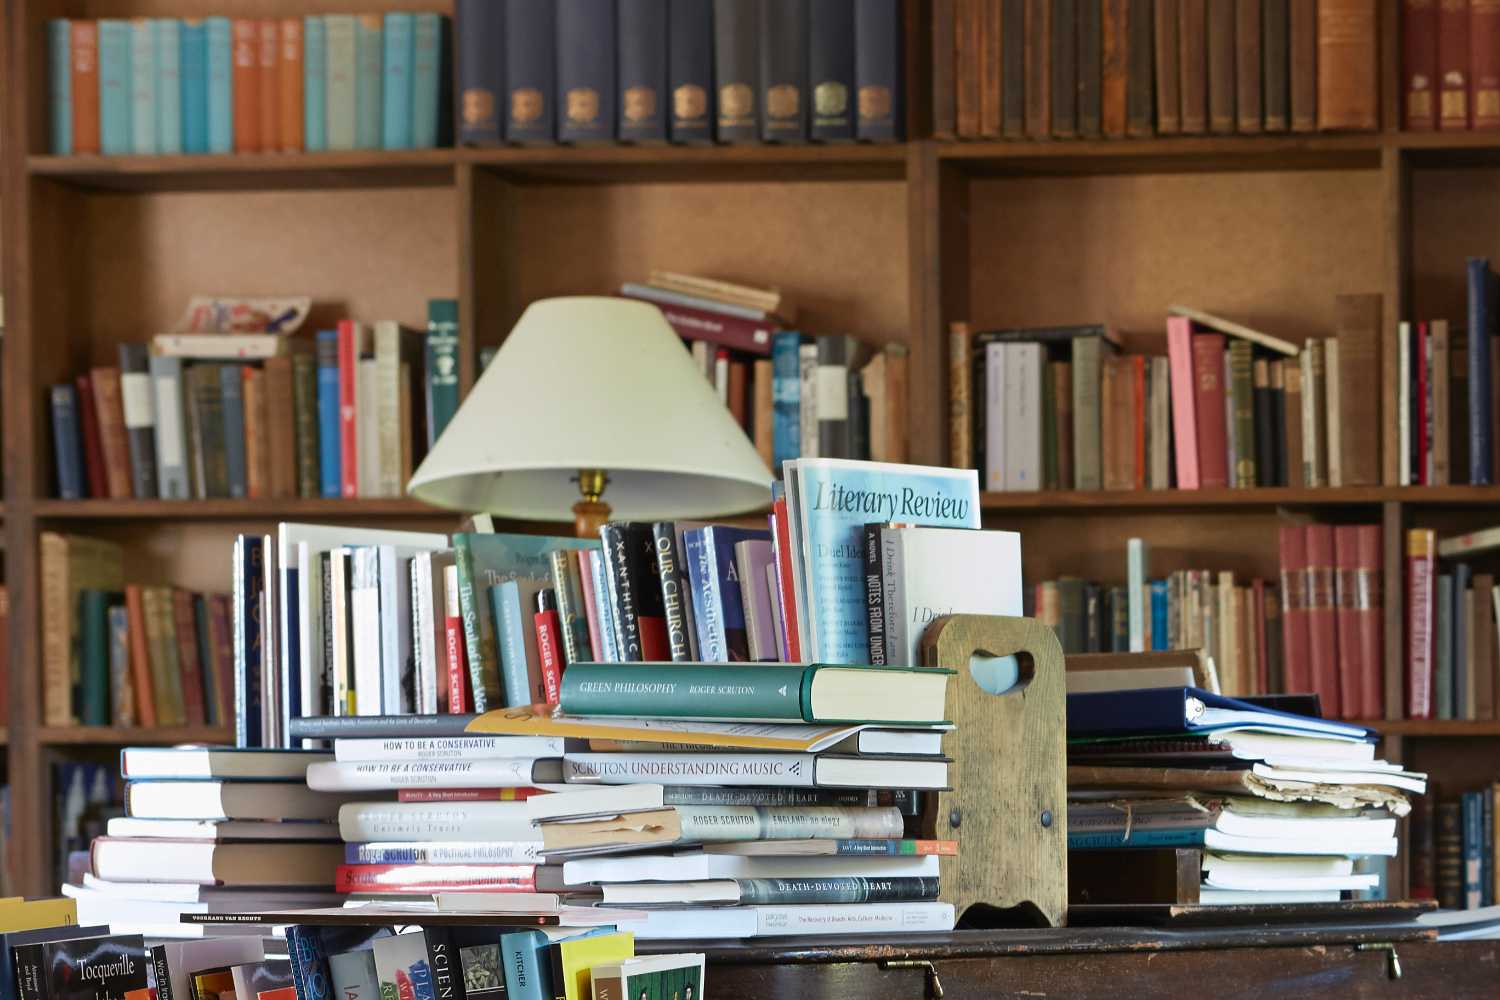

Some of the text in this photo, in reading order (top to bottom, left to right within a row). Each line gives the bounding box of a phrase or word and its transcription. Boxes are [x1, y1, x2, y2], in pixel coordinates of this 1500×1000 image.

[813, 481, 969, 521] Literary Review
[886, 548, 898, 578] Drink
[461, 583, 473, 605] The
[616, 541, 638, 653] XANTHIPPIC
[656, 537, 686, 657] OUR CHURCH
[887, 580, 899, 633] Therefore
[463, 611, 477, 643] Soul
[701, 575, 721, 663] Aesthetics
[866, 575, 885, 666] NOTES FROM UNDER
[447, 628, 459, 670] ROGER
[469, 645, 481, 662] of
[539, 624, 553, 667] ROGER
[472, 665, 484, 689] the
[580, 682, 678, 694] GREEN PHILOSOPHY
[689, 685, 755, 695] ROGER SCRUTON
[383, 738, 497, 751] HOW TO BE A CONSERVATIVE
[356, 762, 473, 773] HOW TO BE A CONSERVATIVE
[572, 760, 784, 776] SCRUTON UNDERSTANDING MUSIC
[693, 815, 755, 825] ROGER SCRUTON
[358, 847, 427, 864] Roger SCRUTON
[778, 881, 893, 891] DEATH-DEVOTED HEART
[77, 953, 136, 985] Tocqueville
[156, 960, 165, 979] War
[514, 951, 527, 988] KITCHER
